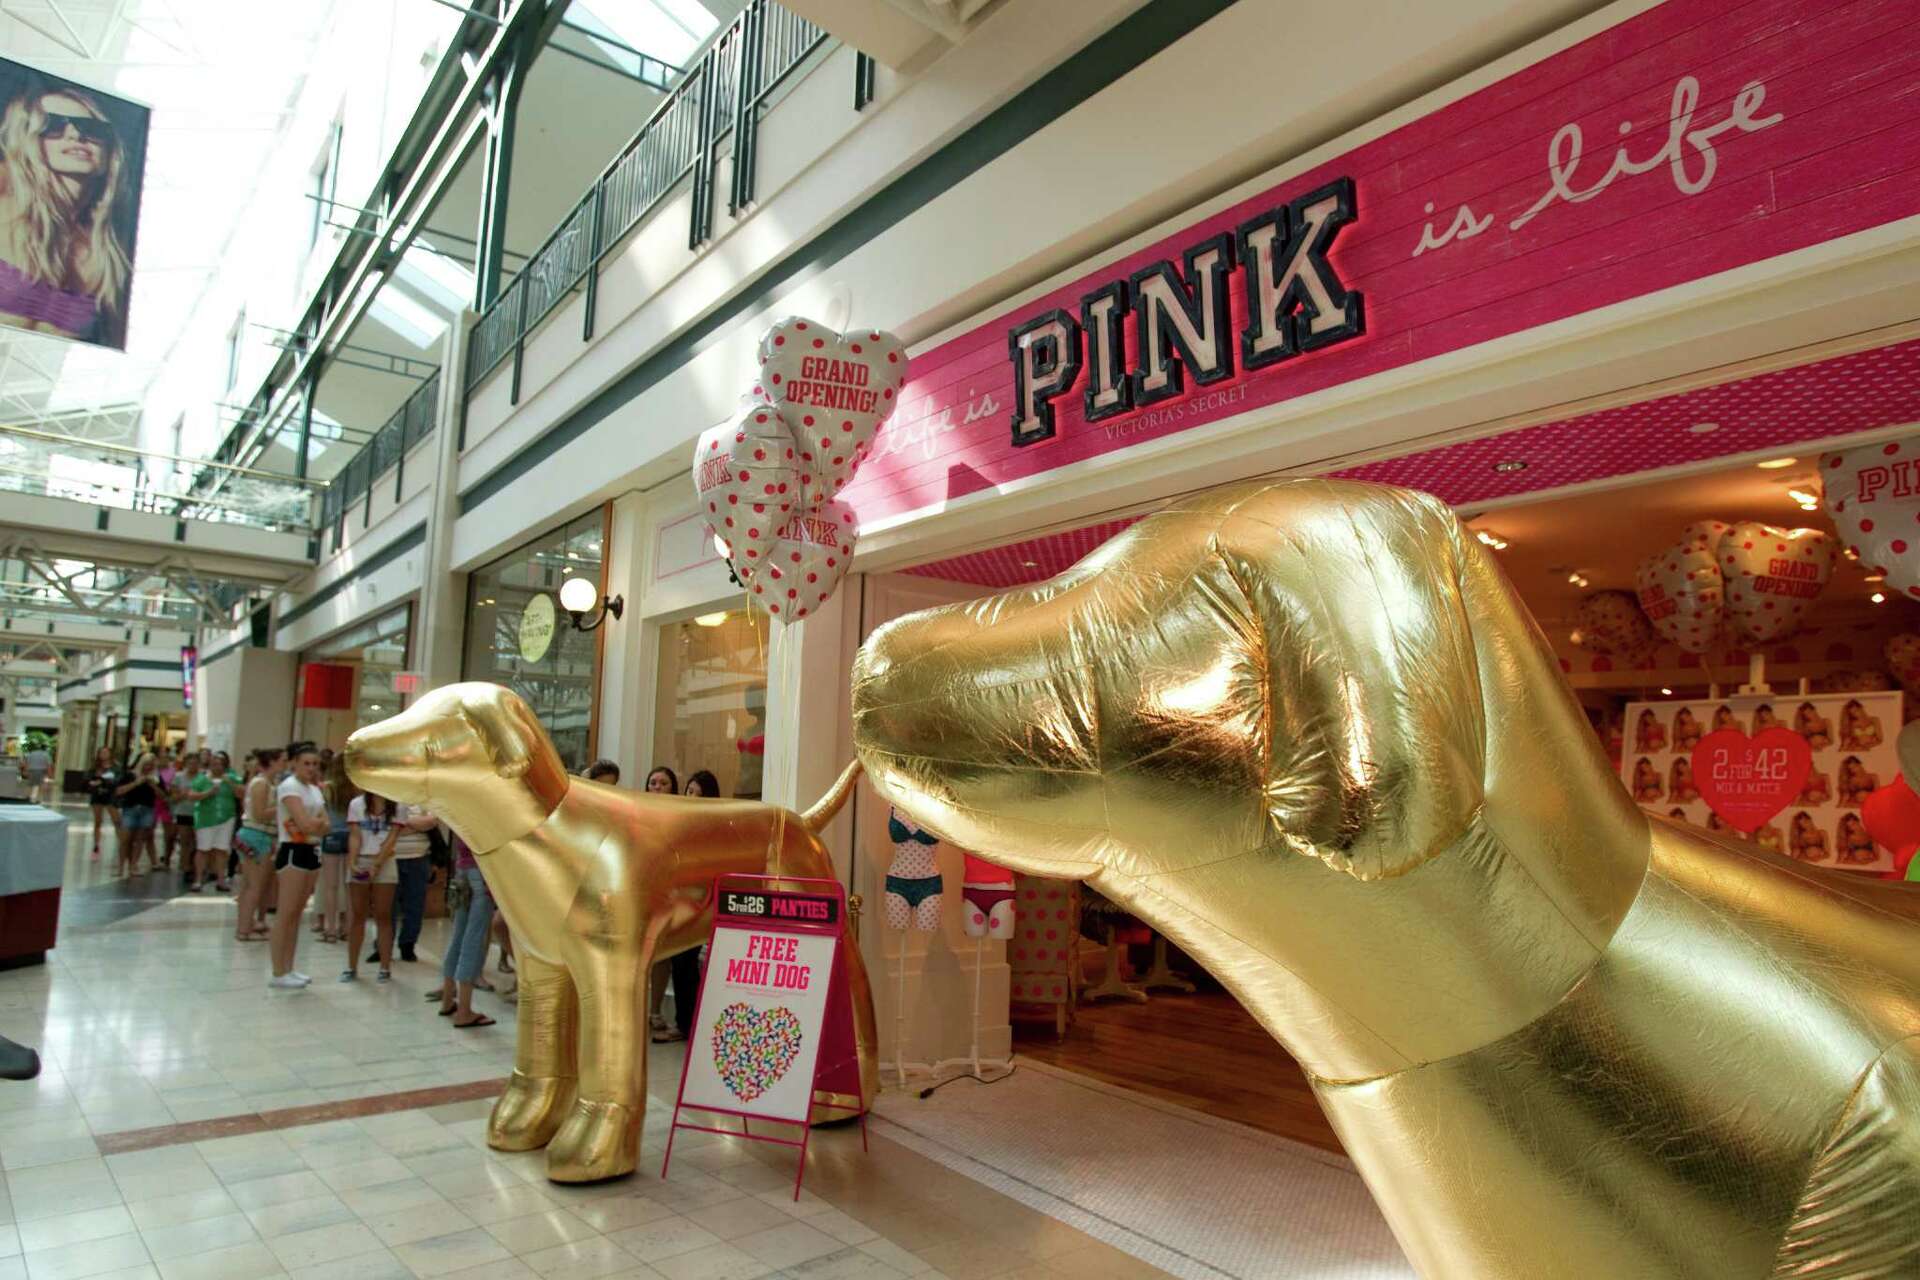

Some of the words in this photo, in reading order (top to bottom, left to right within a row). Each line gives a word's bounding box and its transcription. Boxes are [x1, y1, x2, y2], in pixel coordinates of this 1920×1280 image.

[1411, 201, 1495, 257] is
[1509, 75, 1784, 231] life
[1008, 176, 1367, 447] PINK
[801, 355, 869, 387] GRAND
[786, 380, 878, 414] OPENING!
[963, 387, 1000, 424] is
[1103, 403, 1185, 440] VICTORIA'S
[1189, 383, 1249, 416] SECRET
[699, 453, 733, 492] INK
[781, 515, 839, 547] INK
[1712, 748, 1729, 779] 2
[727, 894, 738, 912] 5
[770, 898, 829, 919] PANTIES
[746, 935, 800, 962] FREE
[726, 959, 770, 986] MINI
[773, 963, 811, 990] DOG
